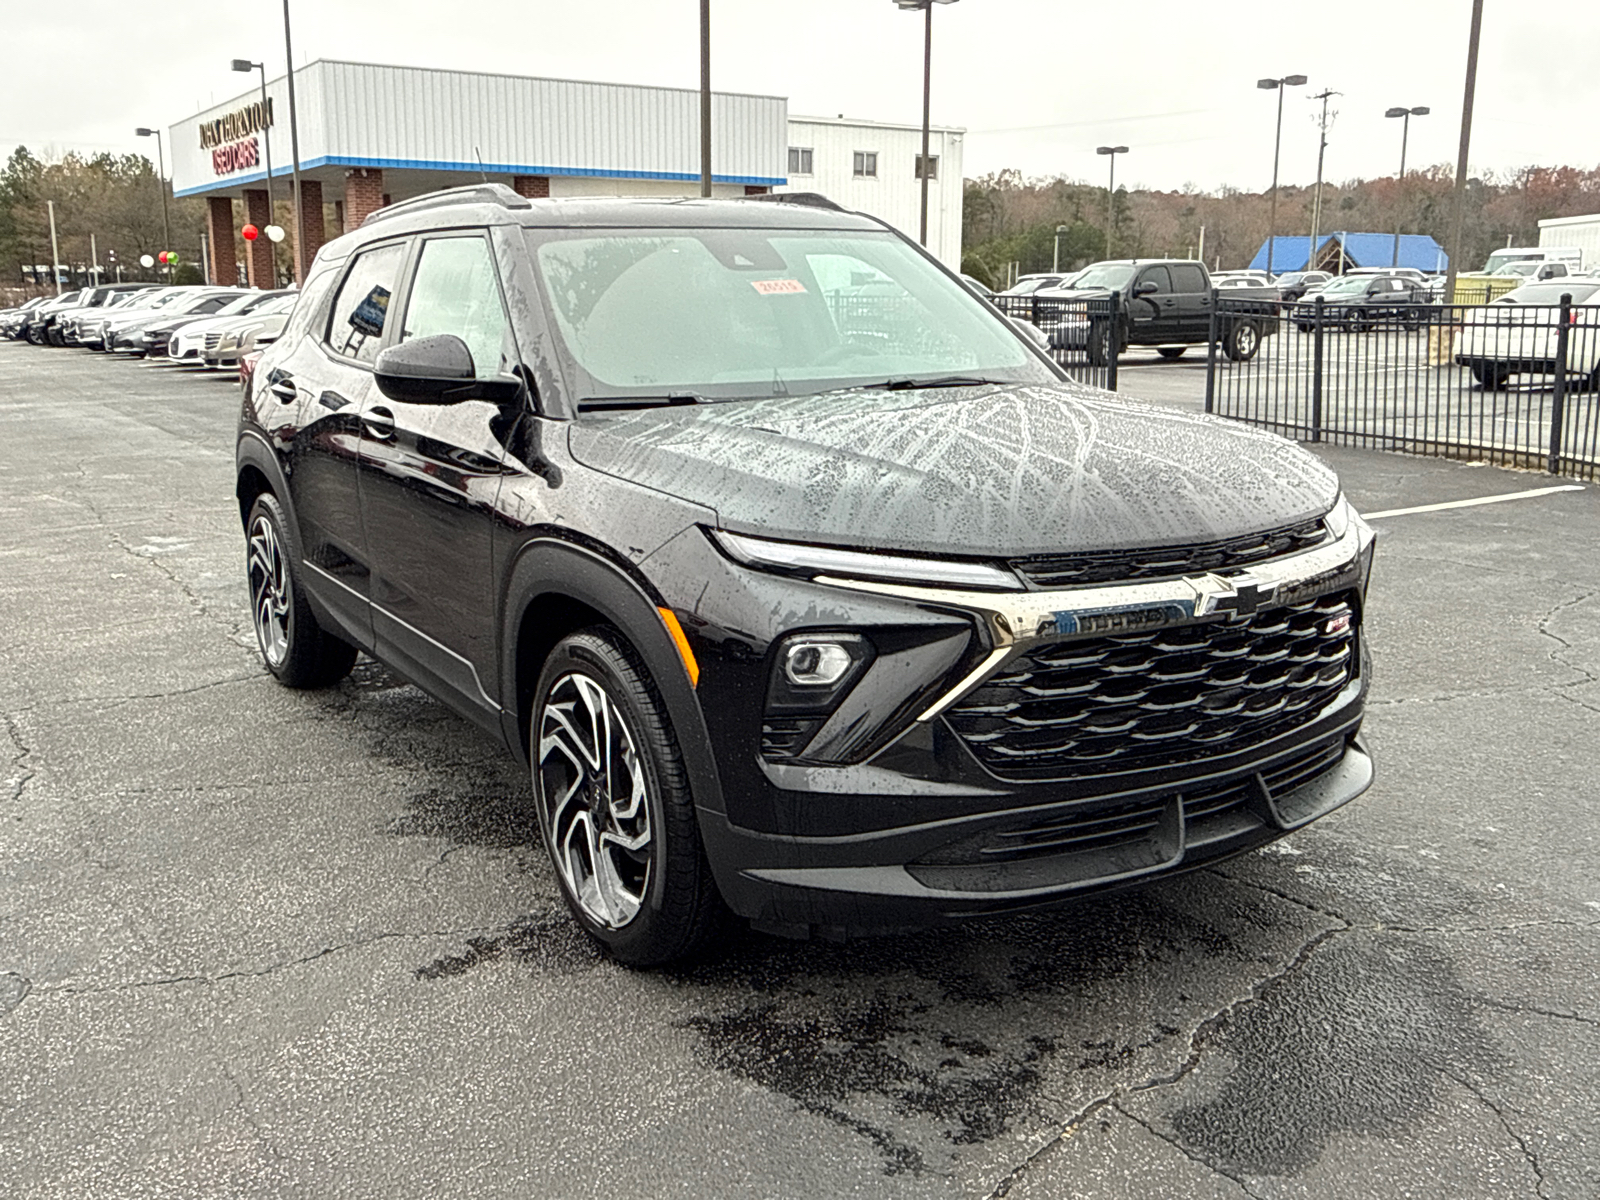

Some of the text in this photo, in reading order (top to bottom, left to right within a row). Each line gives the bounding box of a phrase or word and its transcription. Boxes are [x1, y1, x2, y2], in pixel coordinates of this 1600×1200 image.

[199, 119, 221, 149] JOHN
[212, 137, 260, 174] USED CARS
